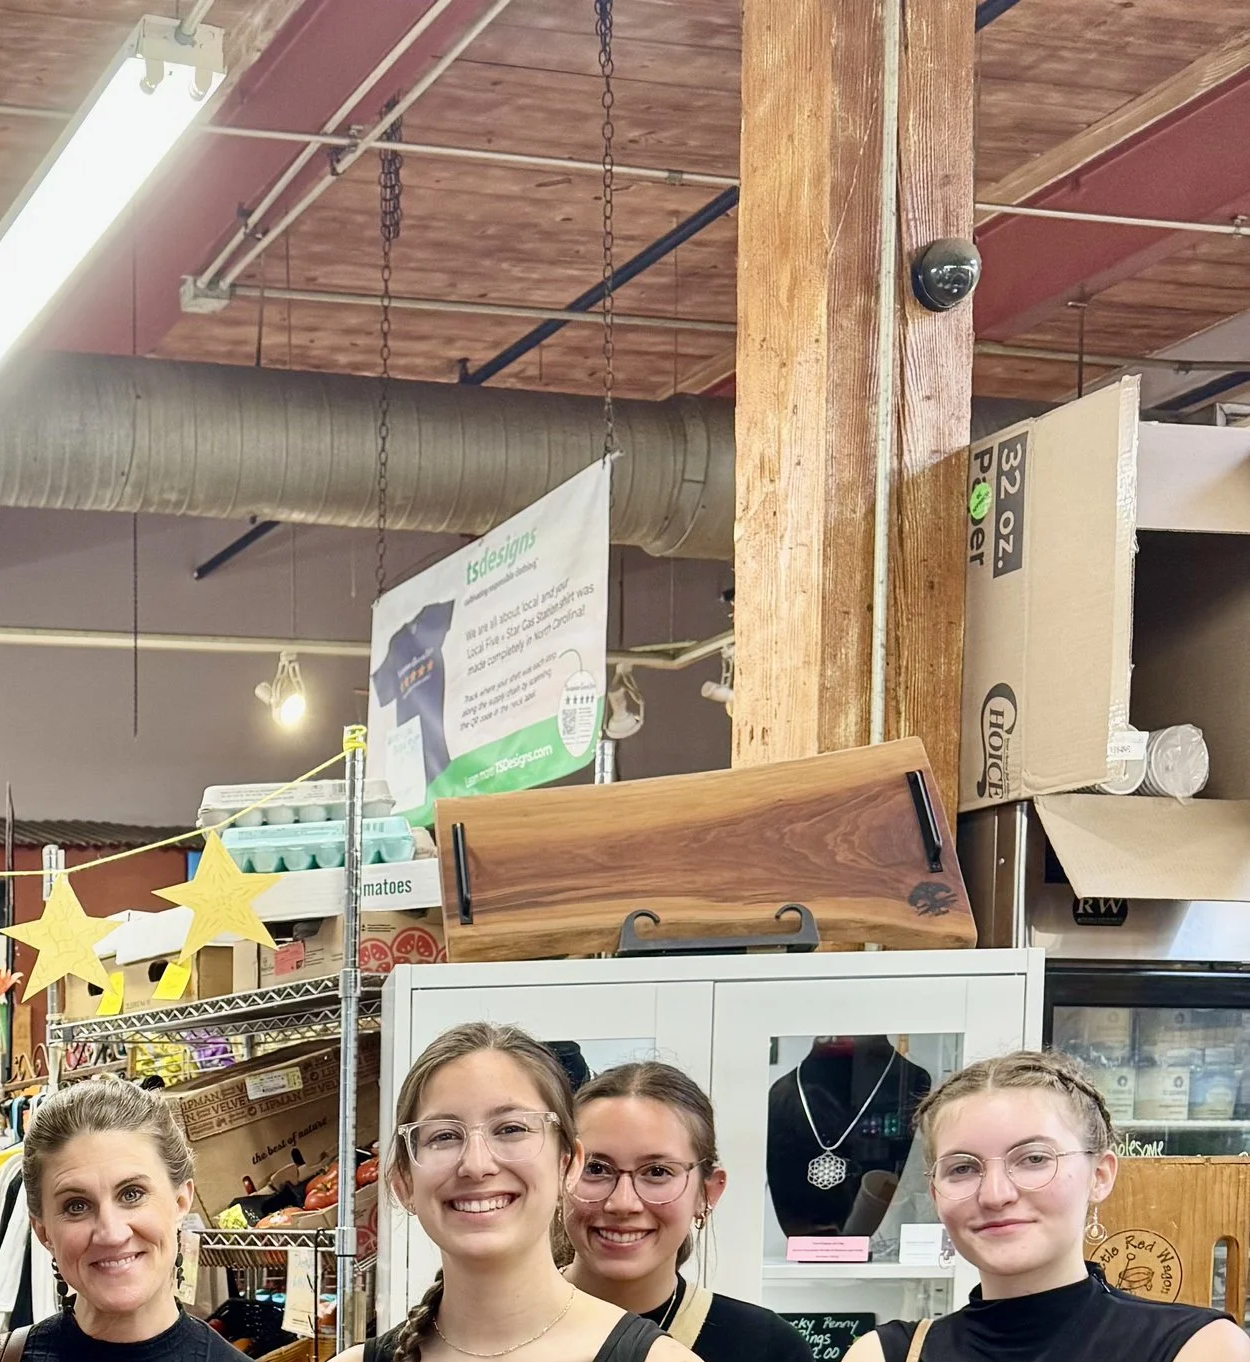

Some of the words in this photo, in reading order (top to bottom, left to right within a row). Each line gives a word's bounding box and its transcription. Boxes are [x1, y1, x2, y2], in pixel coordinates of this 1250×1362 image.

[1000, 443, 1022, 499] 32
[969, 446, 994, 566] Per
[466, 527, 537, 585] tsdesigns
[998, 511, 1015, 568] oz.
[467, 641, 485, 659] Local
[522, 617, 535, 631] Gas
[577, 583, 595, 599] was
[499, 605, 520, 625] about
[522, 593, 539, 612] local
[488, 639, 524, 667] completely
[977, 683, 1017, 799] CHOICE
[360, 878, 413, 897] matoes
[1076, 898, 1124, 914] RW
[259, 1091, 303, 1114] LIPMAN
[252, 1150, 267, 1165] the
[286, 1131, 298, 1148] of
[298, 1116, 328, 1138] nature
[1112, 1132, 1164, 1157] olesome
[1125, 1234, 1157, 1253] Red
[1157, 1248, 1175, 1295] Wagon
[791, 1317, 815, 1336] cky
[822, 1315, 859, 1335] Penny
